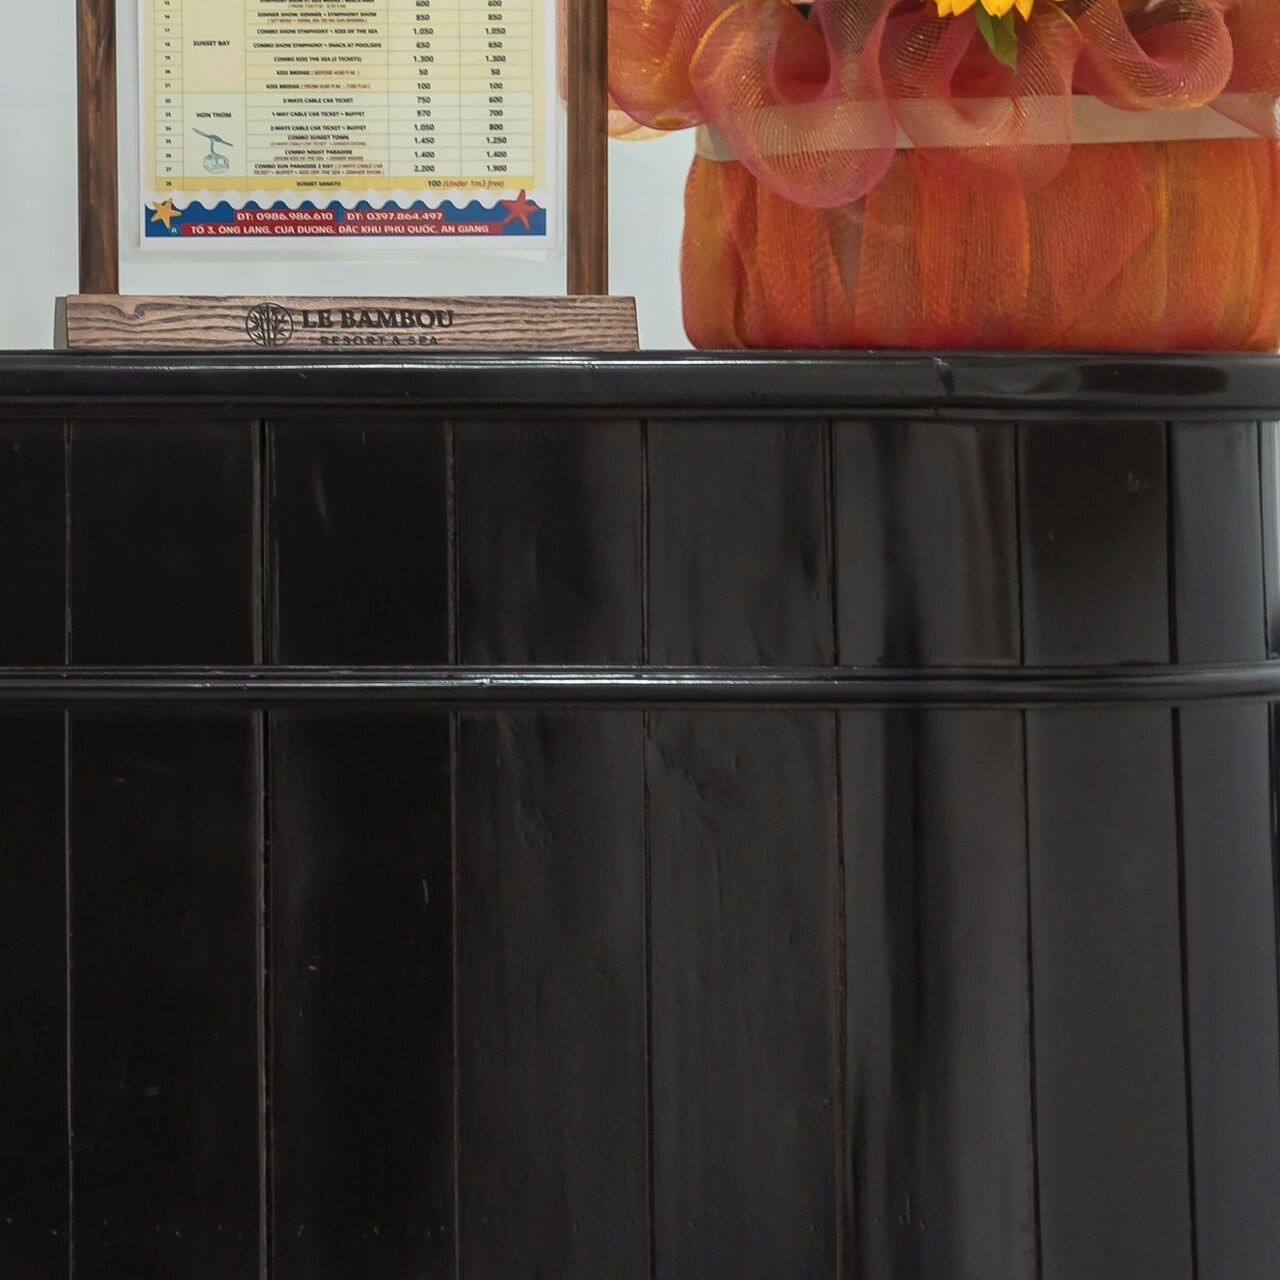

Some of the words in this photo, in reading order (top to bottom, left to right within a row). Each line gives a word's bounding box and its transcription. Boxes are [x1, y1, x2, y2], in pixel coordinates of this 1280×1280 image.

[413, 27, 434, 35] 1.050
[485, 27, 506, 35] 1.050
[413, 55, 434, 63] 1.300
[485, 55, 506, 63] 1.300
[418, 68, 429, 76] 50
[490, 68, 501, 76] 50
[417, 82, 431, 90] 100
[489, 82, 503, 90] 100
[416, 96, 431, 104] 750
[488, 109, 503, 117] 700
[414, 123, 435, 131] 1.050
[486, 136, 507, 144] 1.250
[486, 164, 508, 172] 1.900
[361, 225, 382, 233] KHU
[441, 225, 455, 233] AN
[457, 225, 489, 233] GIANG
[301, 309, 334, 329] LE
[340, 309, 454, 329] BAMBOU
[320, 336, 386, 346] RESORT
[392, 336, 400, 346] &
[409, 336, 439, 346] SPA
